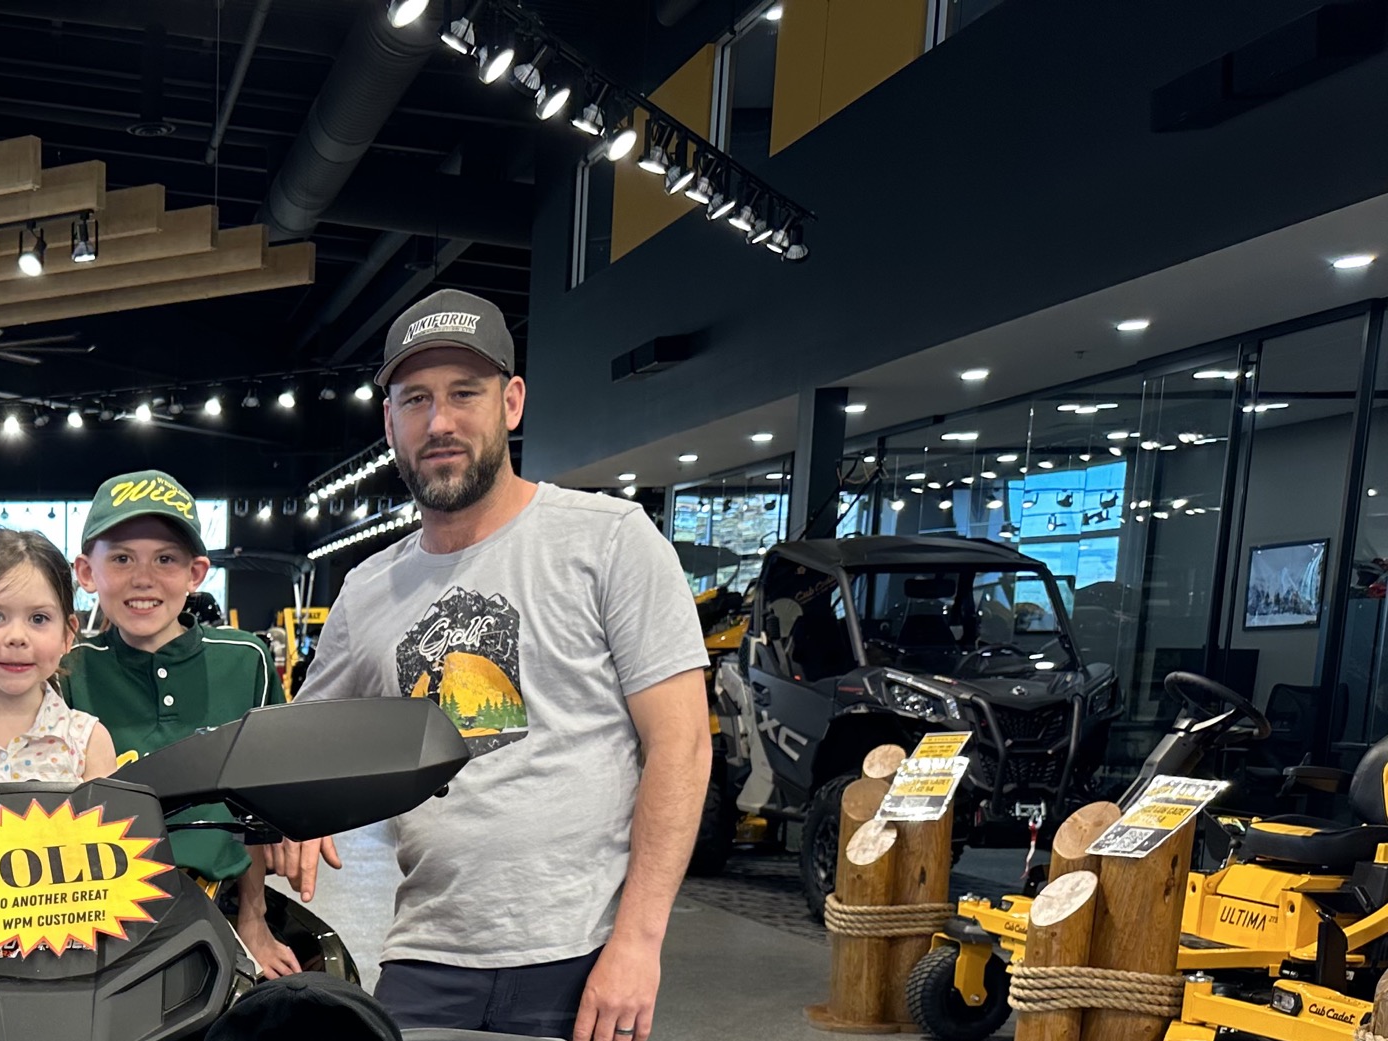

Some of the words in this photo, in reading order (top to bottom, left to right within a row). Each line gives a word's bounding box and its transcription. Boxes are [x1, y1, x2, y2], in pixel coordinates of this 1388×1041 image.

[111, 480, 194, 519] Wild
[419, 616, 494, 661] Golf
[12, 893, 67, 908] ANOTHER
[72, 889, 109, 903] GREAT
[3, 917, 32, 930] WPM
[37, 910, 106, 927] CUSTOMER!
[1220, 905, 1267, 932] ULTIMA
[1308, 1003, 1326, 1017] Cub
[1326, 1008, 1356, 1026] Cadet
